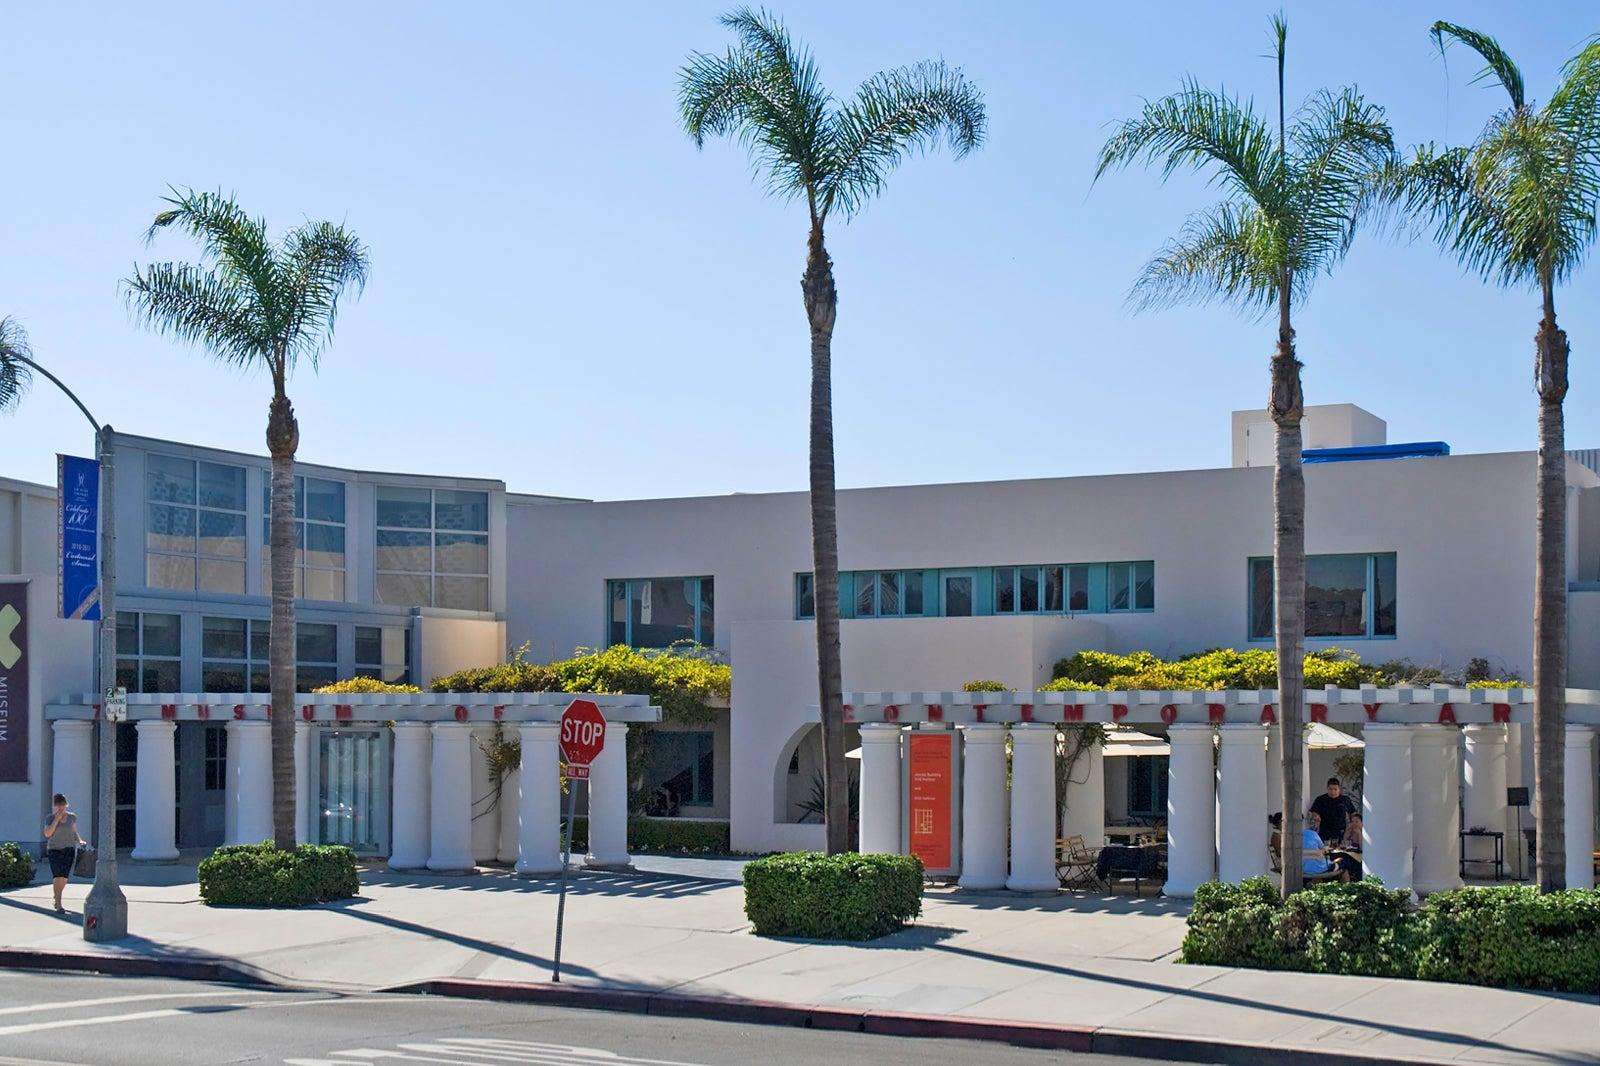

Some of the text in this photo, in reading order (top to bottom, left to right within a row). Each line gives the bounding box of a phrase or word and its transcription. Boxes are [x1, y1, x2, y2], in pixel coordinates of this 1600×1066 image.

[106, 687, 113, 698] 2
[0, 676, 9, 742] MUSEUM
[161, 703, 1512, 723] MUSUM OF CONTEMPORARY AR
[562, 717, 603, 746] STOP
[567, 767, 588, 777] ALL WAY
